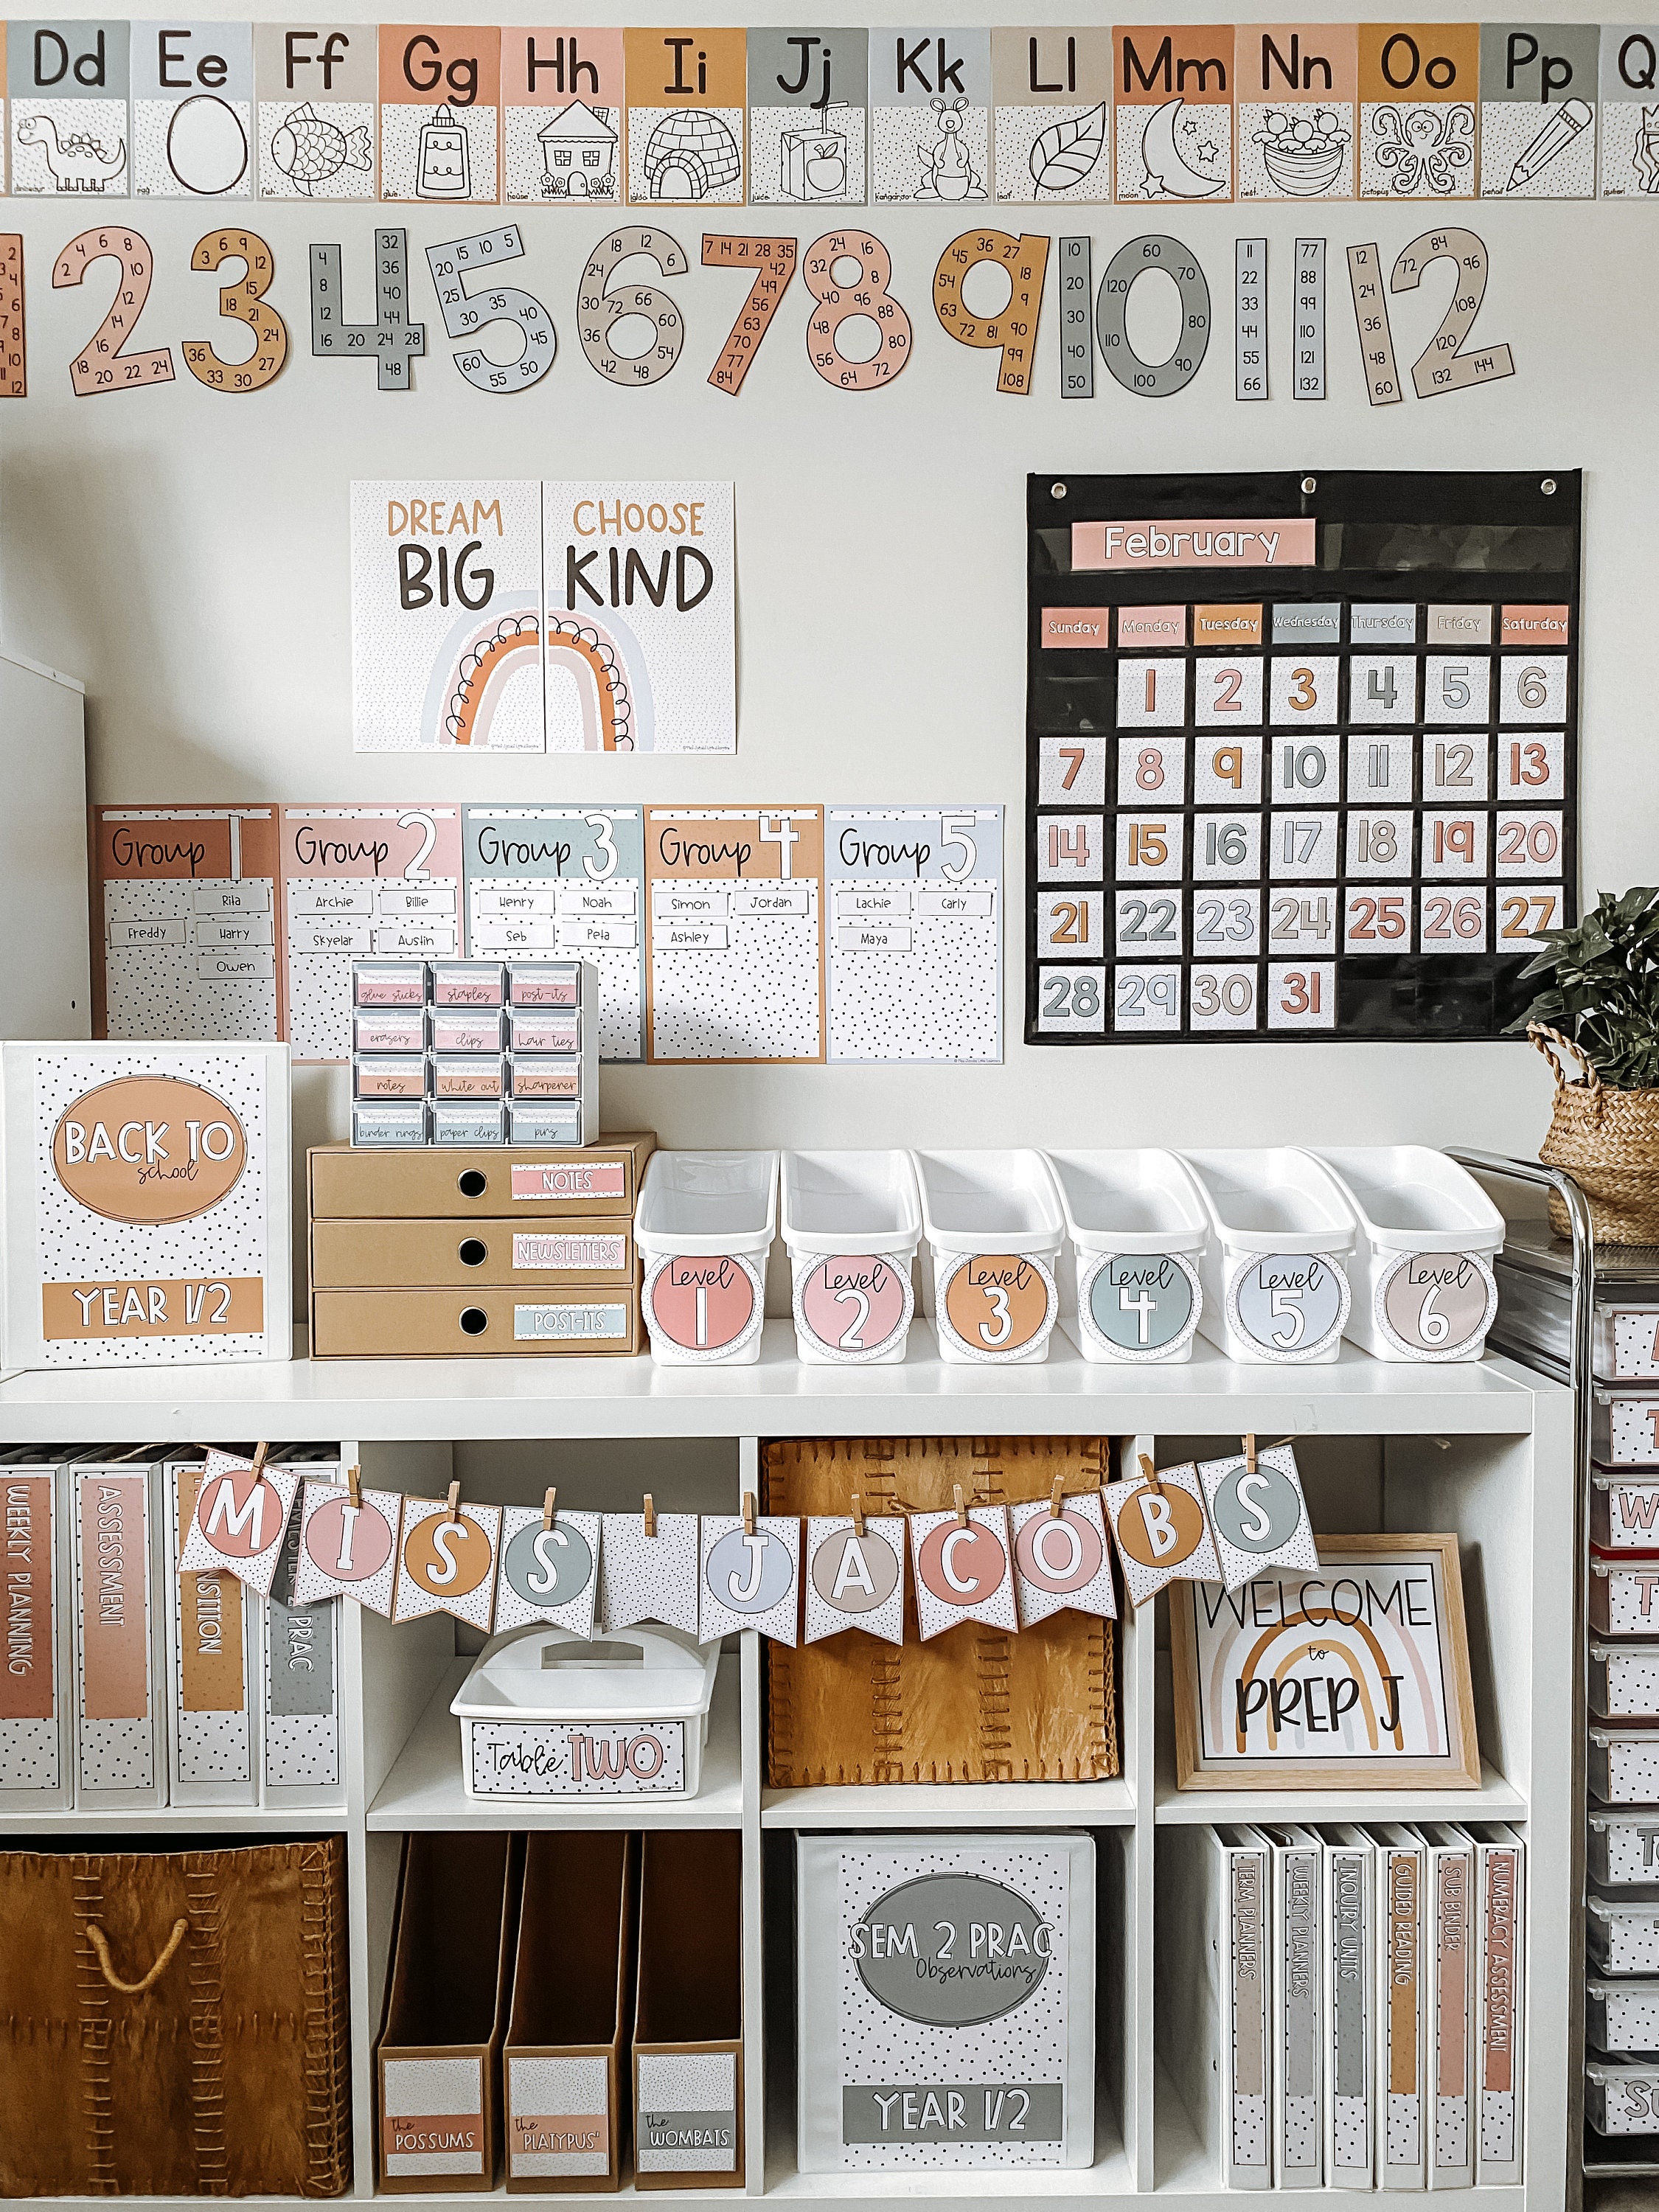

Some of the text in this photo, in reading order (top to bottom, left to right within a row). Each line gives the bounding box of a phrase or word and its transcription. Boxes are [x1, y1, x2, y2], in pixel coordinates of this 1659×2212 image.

[35, 29, 105, 87] Dd
[158, 30, 229, 88] Ee
[285, 31, 349, 90] Ff
[403, 35, 479, 106] Gg
[527, 37, 599, 94] Hh
[664, 38, 706, 94] Ii
[776, 38, 832, 109] Jj
[897, 38, 964, 94] Kk
[1029, 37, 1075, 93] Ll
[1123, 35, 1226, 94] Mm
[1262, 33, 1332, 91] Nn
[1381, 32, 1456, 90] Oo
[1506, 32, 1573, 104] Pp
[99, 235, 108, 249] 6
[382, 236, 399, 249] 32
[737, 243, 749, 257] 21
[254, 255, 267, 270] 12
[52, 226, 175, 396] 2
[182, 228, 287, 393] 3
[425, 224, 557, 393] 5
[490, 296, 507, 310] 35
[635, 293, 653, 307] 66
[803, 229, 912, 391] 8
[933, 229, 1051, 394] 9
[189, 348, 206, 363] 36
[888, 335, 906, 349] 80
[1301, 351, 1316, 364] 121
[151, 359, 169, 375] 24
[462, 357, 481, 371] 60
[1003, 375, 1023, 388] 108
[1133, 375, 1156, 389] 100
[1475, 357, 1495, 373] 144
[388, 500, 503, 536] DREAM
[574, 501, 706, 536] CHOOSE
[1105, 526, 1280, 563] February
[398, 541, 494, 610] BIG
[567, 546, 713, 611] KIND
[1048, 615, 1568, 636] Sunday Monday Tuesday Wednesday Thursday Friday Saturday
[1145, 669, 1155, 712] 1
[1442, 667, 1470, 709] 5
[1284, 745, 1326, 787] 10
[1510, 742, 1549, 785] 13
[113, 815, 241, 881] Group 1
[296, 812, 437, 880] Group 2
[479, 813, 619, 881] Group 3
[660, 815, 799, 880] Group 4
[840, 815, 977, 882] Group 5
[1206, 823, 1247, 865] 16
[316, 896, 354, 908] Archie
[406, 896, 428, 907] Billie
[500, 896, 533, 911] Henry
[582, 897, 611, 909] Noah
[672, 897, 710, 911] Simon
[751, 895, 791, 908] Jordan
[856, 897, 891, 910] Lachie
[942, 897, 967, 911] Carly
[1272, 897, 1330, 939] 24
[128, 926, 167, 940] Freddy
[398, 934, 434, 946] Austin
[216, 961, 255, 973] Owen
[361, 990, 422, 1002] glue sticks
[448, 987, 491, 1001] staples
[521, 989, 567, 1001] post-its
[1281, 972, 1321, 1015] 31
[456, 1034, 483, 1048] clips
[519, 1034, 574, 1048] hair ties
[377, 1080, 405, 1093] notes
[442, 1081, 498, 1093] white out
[65, 1121, 234, 1164] BACK TO
[440, 1127, 498, 1140] paper clips
[138, 1159, 198, 1184] school
[542, 1170, 594, 1191] NOTES
[518, 1242, 619, 1262] NEWSLETTERS
[672, 1260, 734, 1289] Level
[824, 1263, 887, 1292] Level
[1110, 1259, 1174, 1290] Level
[1409, 1259, 1474, 1289] Level
[72, 1283, 231, 1326] YEAR 1/2
[534, 1310, 606, 1331] POST-ITS
[696, 1287, 706, 1345] 1
[834, 1287, 870, 1348] 2
[1119, 1288, 1156, 1343] 4
[1419, 1284, 1450, 1345] 6
[97, 1485, 126, 1627] ASSESSMENT
[5, 1485, 35, 1677] WEEKLY PLANNING
[1201, 1579, 1431, 1629] WELCOME
[287, 1615, 314, 1672] PRAC
[1308, 1645, 1329, 1660] to
[1236, 1676, 1404, 1733] PREP J
[487, 1733, 664, 1781] Table TWO
[1237, 1865, 1256, 1980] TERM PLANNERS
[1339, 1867, 1358, 1980] INQUIRY UNITS
[1394, 1864, 1413, 1986] GUIDED READING
[1444, 1867, 1461, 1951] SUB BINDER
[848, 1921, 1055, 1960] SEM 2 PRAC
[1292, 1865, 1309, 1998] WEEKLY PLANNERS
[917, 1957, 1036, 1983] Observations
[1490, 1861, 1509, 2052] NUMERACY ASSESSMENT
[392, 2119, 415, 2132] the
[516, 2118, 538, 2132] the
[645, 2115, 669, 2128] the
[872, 2089, 1030, 2131] YEAR 1/2
[396, 2132, 473, 2151] POSSUMS
[650, 2130, 730, 2147] WOMBATS
